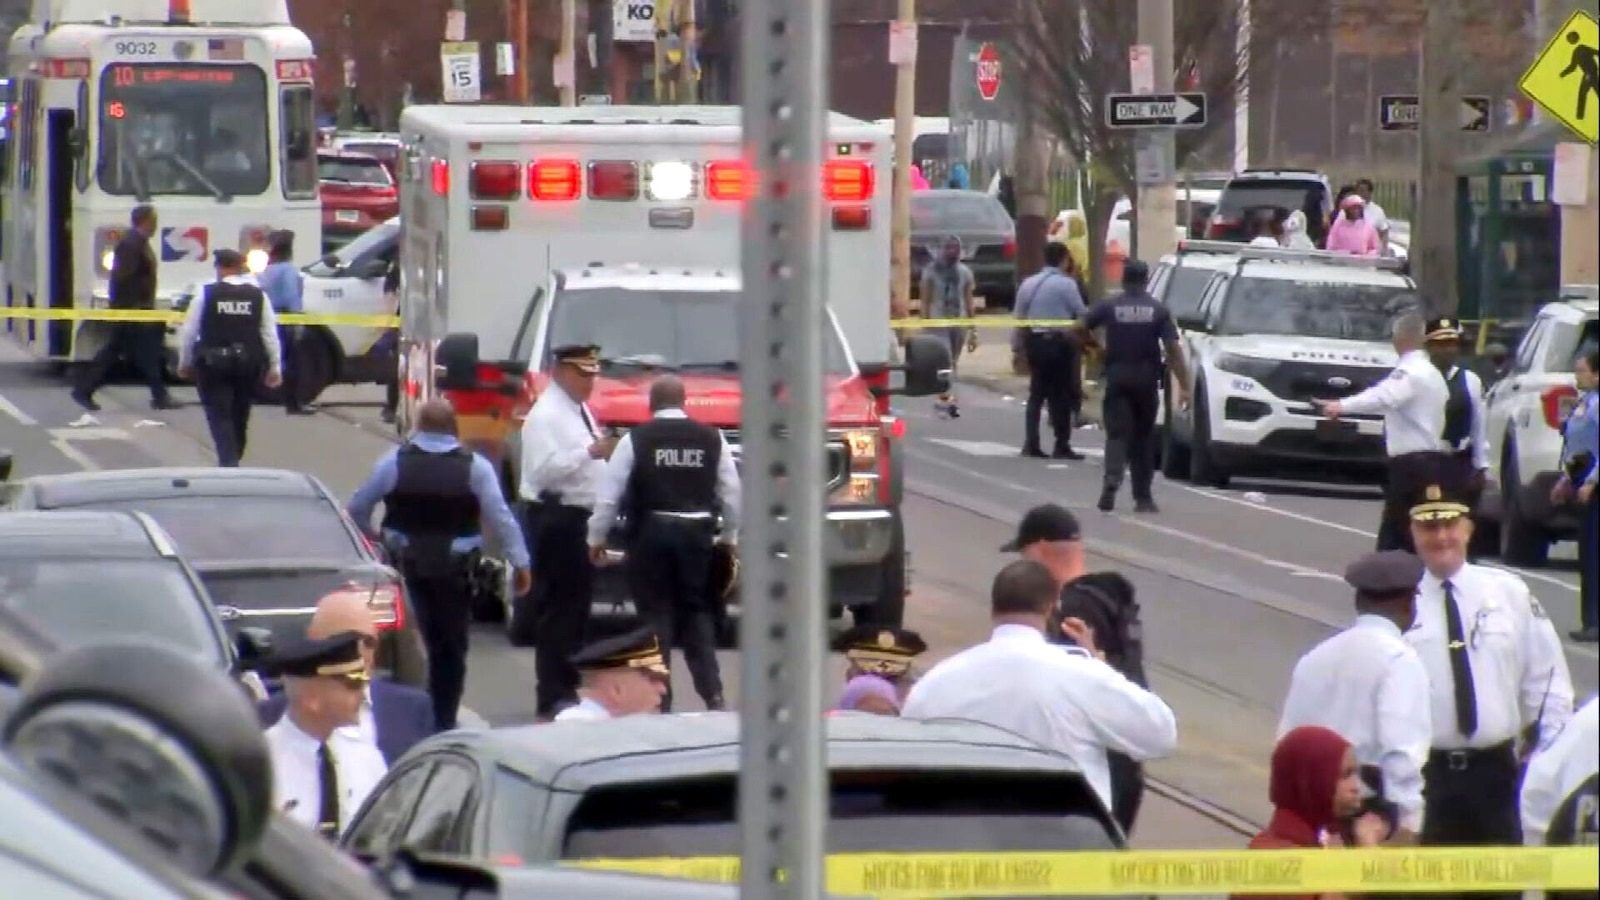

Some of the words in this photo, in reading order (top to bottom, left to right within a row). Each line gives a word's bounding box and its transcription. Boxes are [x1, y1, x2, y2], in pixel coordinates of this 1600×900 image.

[116, 41, 157, 56] 9032
[978, 60, 1000, 80] STOP
[451, 70, 472, 88] 15
[1120, 104, 1144, 117] ONE
[1149, 103, 1176, 117] WAY
[217, 300, 252, 315] POLICE
[655, 448, 706, 468] POLICE
